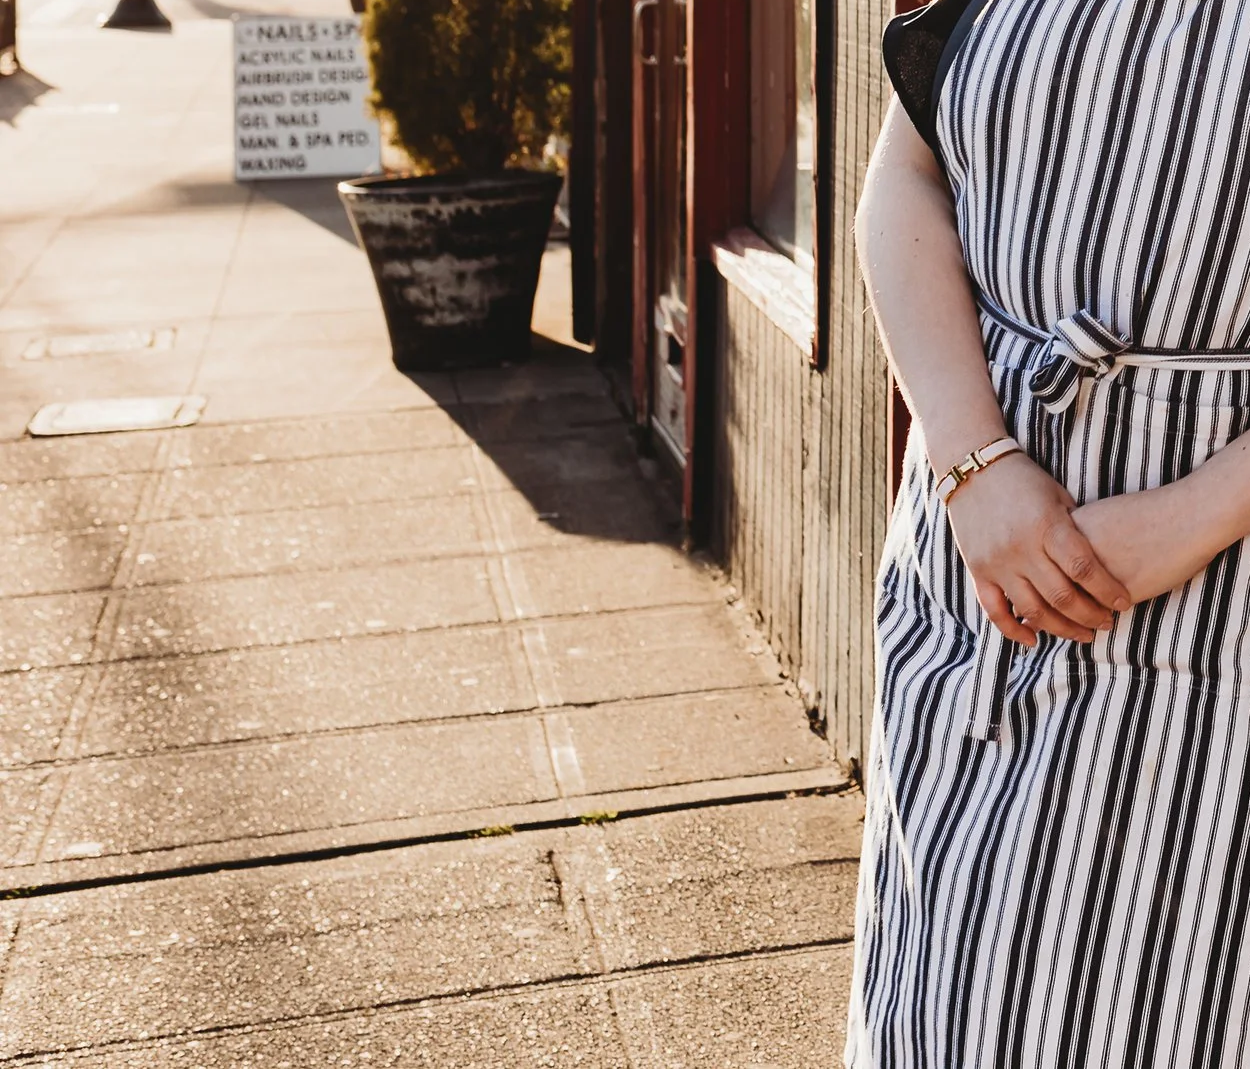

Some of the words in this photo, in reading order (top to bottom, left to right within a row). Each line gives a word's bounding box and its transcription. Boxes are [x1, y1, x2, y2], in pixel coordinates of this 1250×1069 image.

[258, 23, 317, 41] NAILS
[334, 20, 357, 41] SP
[240, 50, 303, 64] ACRYLIC
[311, 48, 354, 62] NAILS
[239, 70, 312, 84] AIRBRUSH
[319, 68, 367, 83] DESIG
[239, 92, 284, 107] HAND
[291, 90, 350, 106] DESIGN
[240, 114, 268, 129] GEL
[277, 111, 318, 127] NAILS
[289, 133, 299, 148] &
[306, 132, 332, 147] SPA
[240, 156, 306, 172] WAXING
